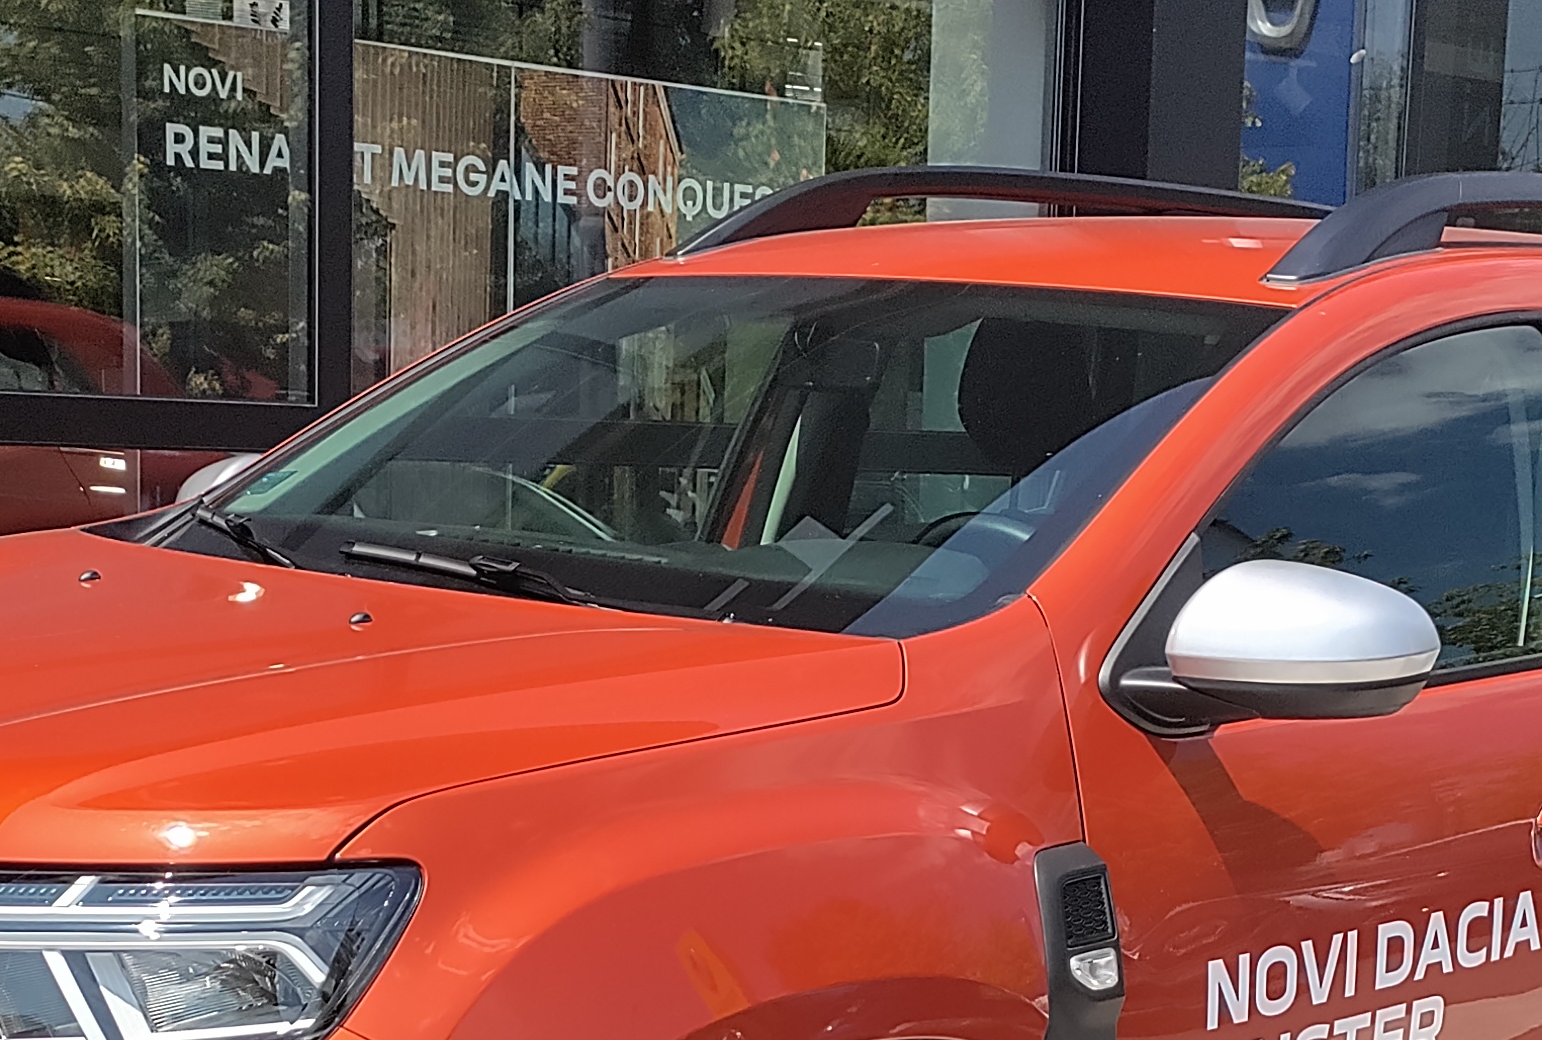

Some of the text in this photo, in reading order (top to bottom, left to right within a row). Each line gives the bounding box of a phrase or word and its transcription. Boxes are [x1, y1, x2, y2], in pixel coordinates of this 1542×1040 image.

[163, 63, 243, 100] NOVI
[165, 122, 382, 184] RENAT
[391, 147, 579, 204] MEGANE
[1206, 890, 1542, 1030] NOVI DACIA
